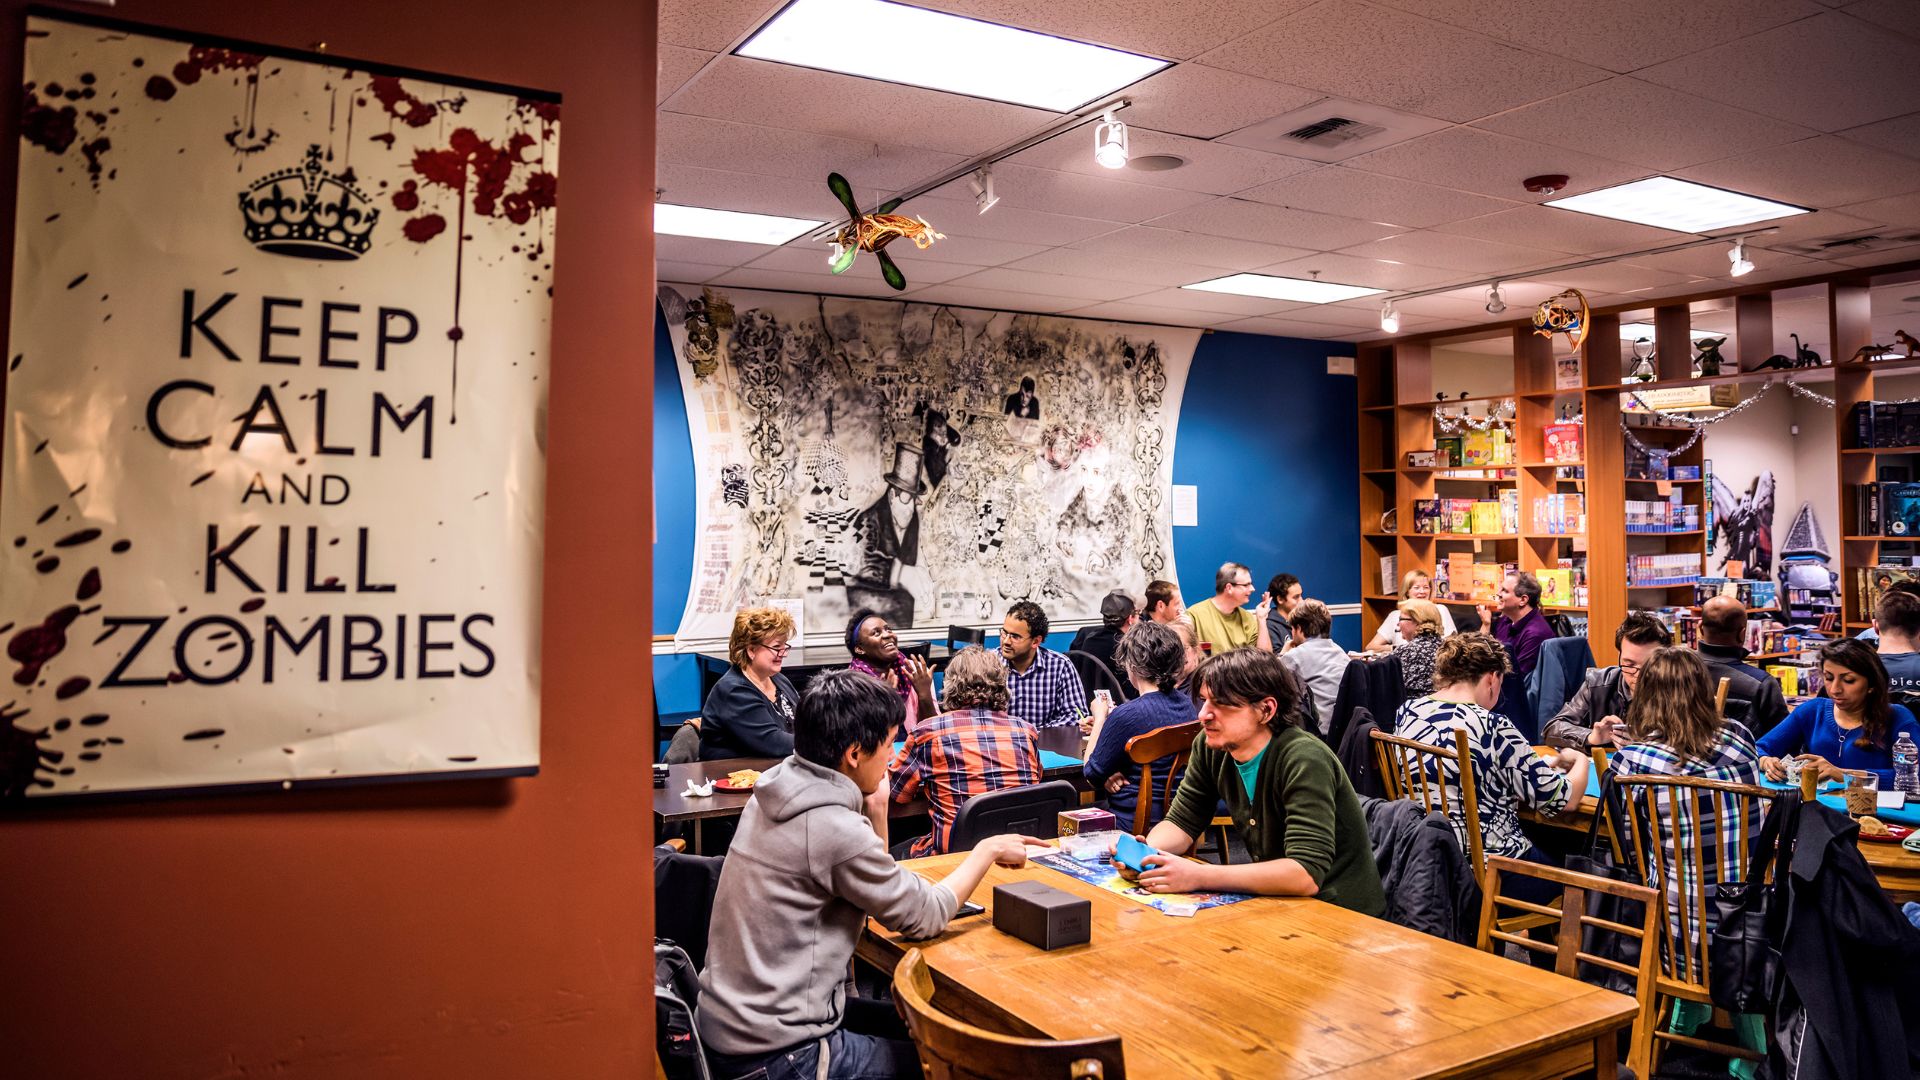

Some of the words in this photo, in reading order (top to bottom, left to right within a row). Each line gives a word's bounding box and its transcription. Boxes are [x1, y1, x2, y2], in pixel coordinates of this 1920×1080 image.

[180, 289, 418, 371] KEEP
[146, 379, 434, 459] CALM
[241, 473, 350, 506] AND
[204, 524, 397, 594] KILL
[98, 613, 496, 689] ZOMBIES
